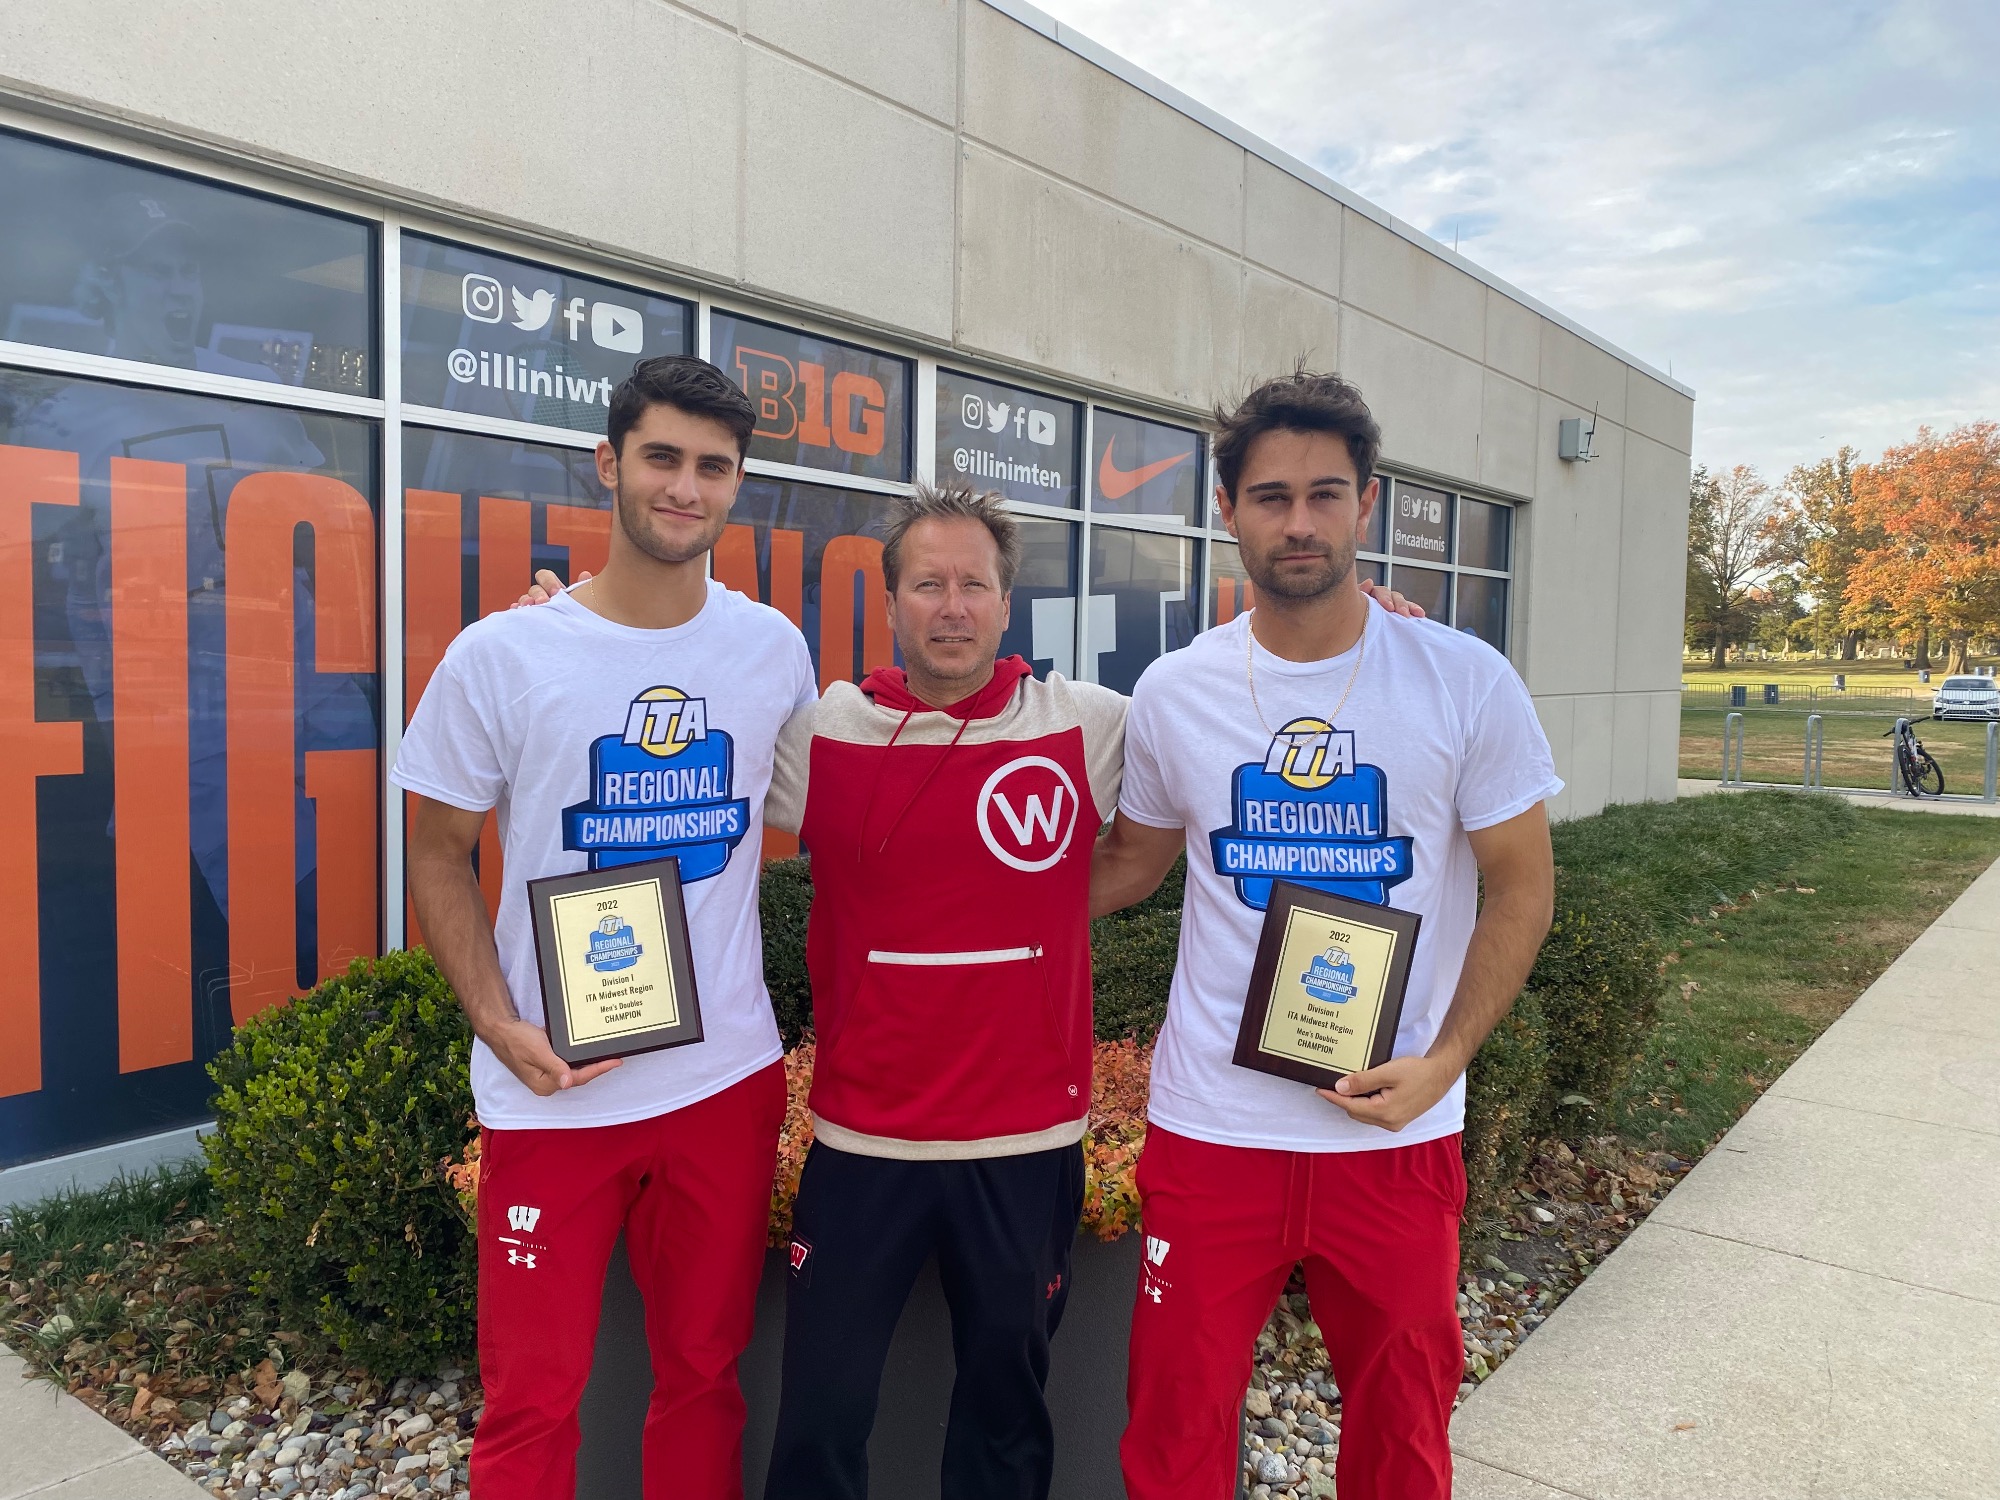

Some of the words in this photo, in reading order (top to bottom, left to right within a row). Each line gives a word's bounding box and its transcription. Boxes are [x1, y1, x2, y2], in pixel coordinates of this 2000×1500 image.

[953, 447, 1061, 489] @illinimten
[1394, 528, 1446, 552] @ncaatennis
[621, 697, 708, 746] ITA
[1261, 730, 1356, 776] ITA
[604, 766, 724, 806] REGIONAL
[991, 785, 1064, 846] W
[1245, 800, 1378, 836] REGIONAL
[582, 807, 738, 844] CHAMPIONSHIPS
[1225, 843, 1397, 873] CHAMPIONSHIPS
[596, 899, 618, 911] 2022
[599, 916, 624, 934] ITA
[594, 936, 632, 951] REGIONAL
[1329, 930, 1351, 943] 2022
[590, 946, 638, 962] CHAMPIONSHIPS
[1322, 949, 1350, 966] ITA
[602, 976, 630, 987] Division
[1314, 965, 1349, 983] REGIONAL
[585, 993, 597, 1002] ITA
[598, 987, 628, 1001] Midwest
[629, 984, 654, 995] Region
[1305, 975, 1352, 995] CHAMPIONSHIPS
[600, 1003, 618, 1013] Men's
[619, 1000, 643, 1010] Doubles
[1307, 1003, 1334, 1017] Division
[604, 1010, 642, 1024] CHAMPION
[1287, 1010, 1299, 1021] ITA
[1300, 1014, 1329, 1028] Midwest
[1329, 1021, 1354, 1036] Region
[1296, 1027, 1314, 1038] Men's
[1315, 1032, 1339, 1045] Doubles
[1297, 1038, 1334, 1055] CHAMPION
[507, 1205, 541, 1233] W
[790, 1241, 808, 1270] W
[1146, 1235, 1171, 1267] W
